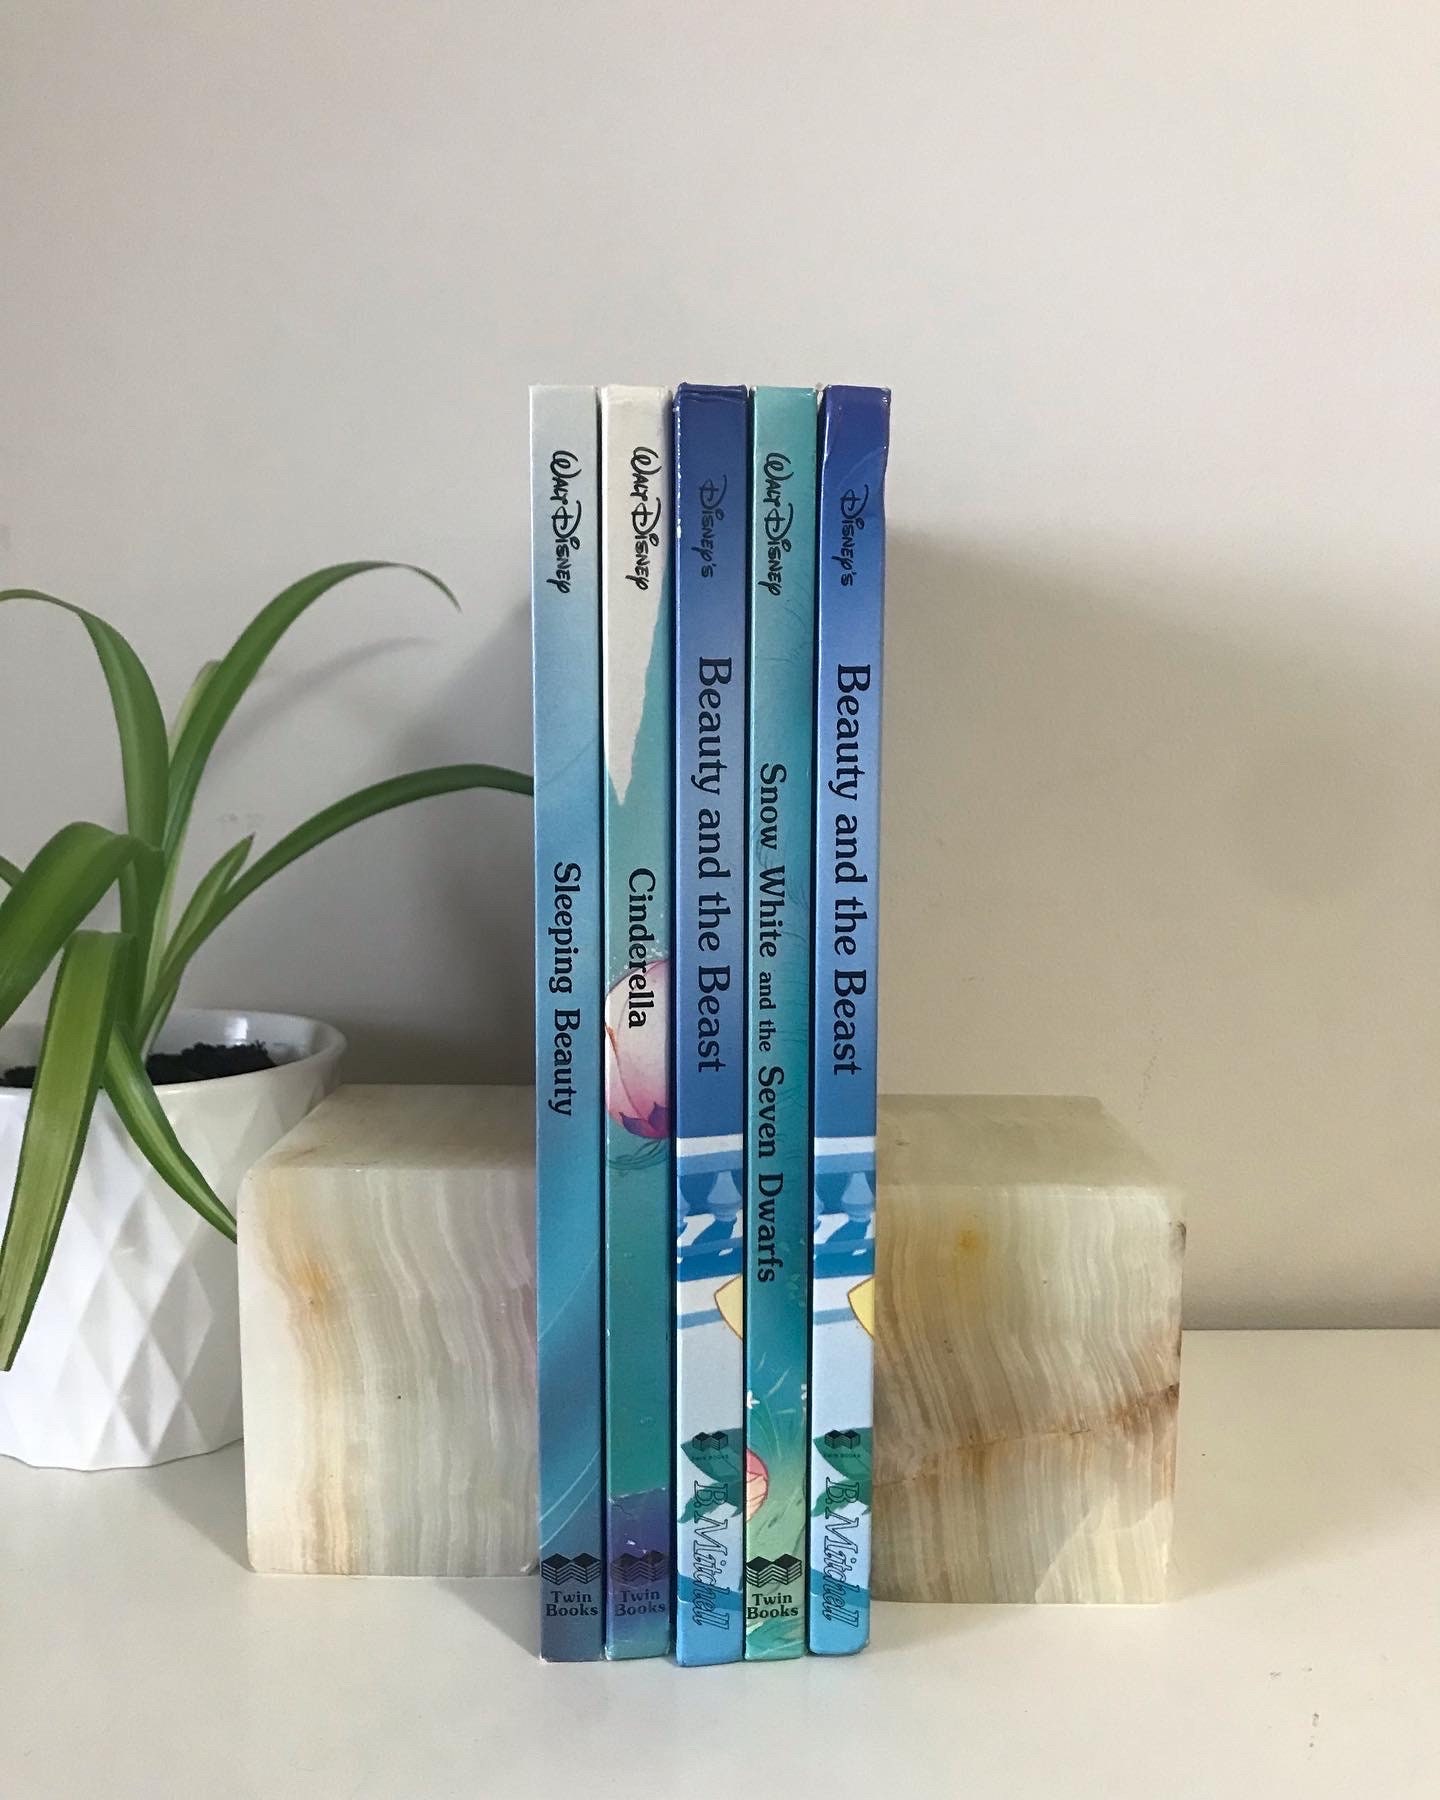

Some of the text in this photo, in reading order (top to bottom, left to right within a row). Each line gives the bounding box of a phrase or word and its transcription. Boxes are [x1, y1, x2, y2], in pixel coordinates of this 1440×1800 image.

[690, 656, 732, 1073] Beauty and the Beast
[828, 663, 871, 1076] Beauty and the Beast
[628, 867, 656, 1029] Cinderella
[547, 861, 582, 1117] Sleeping Beauty
[757, 763, 787, 1283] Snow White and the Seven Dwarfs
[693, 1480, 729, 1508] B.
[825, 1476, 859, 1505] B.
[692, 1511, 731, 1630] Mitchell
[822, 1506, 860, 1627] Mitchell
[546, 1603, 599, 1617] Books
[550, 1589, 592, 1603] Twin
[614, 1602, 666, 1617] Books
[620, 1588, 660, 1603] Twin
[752, 1593, 793, 1606] Twin
[747, 1605, 799, 1619] Books
